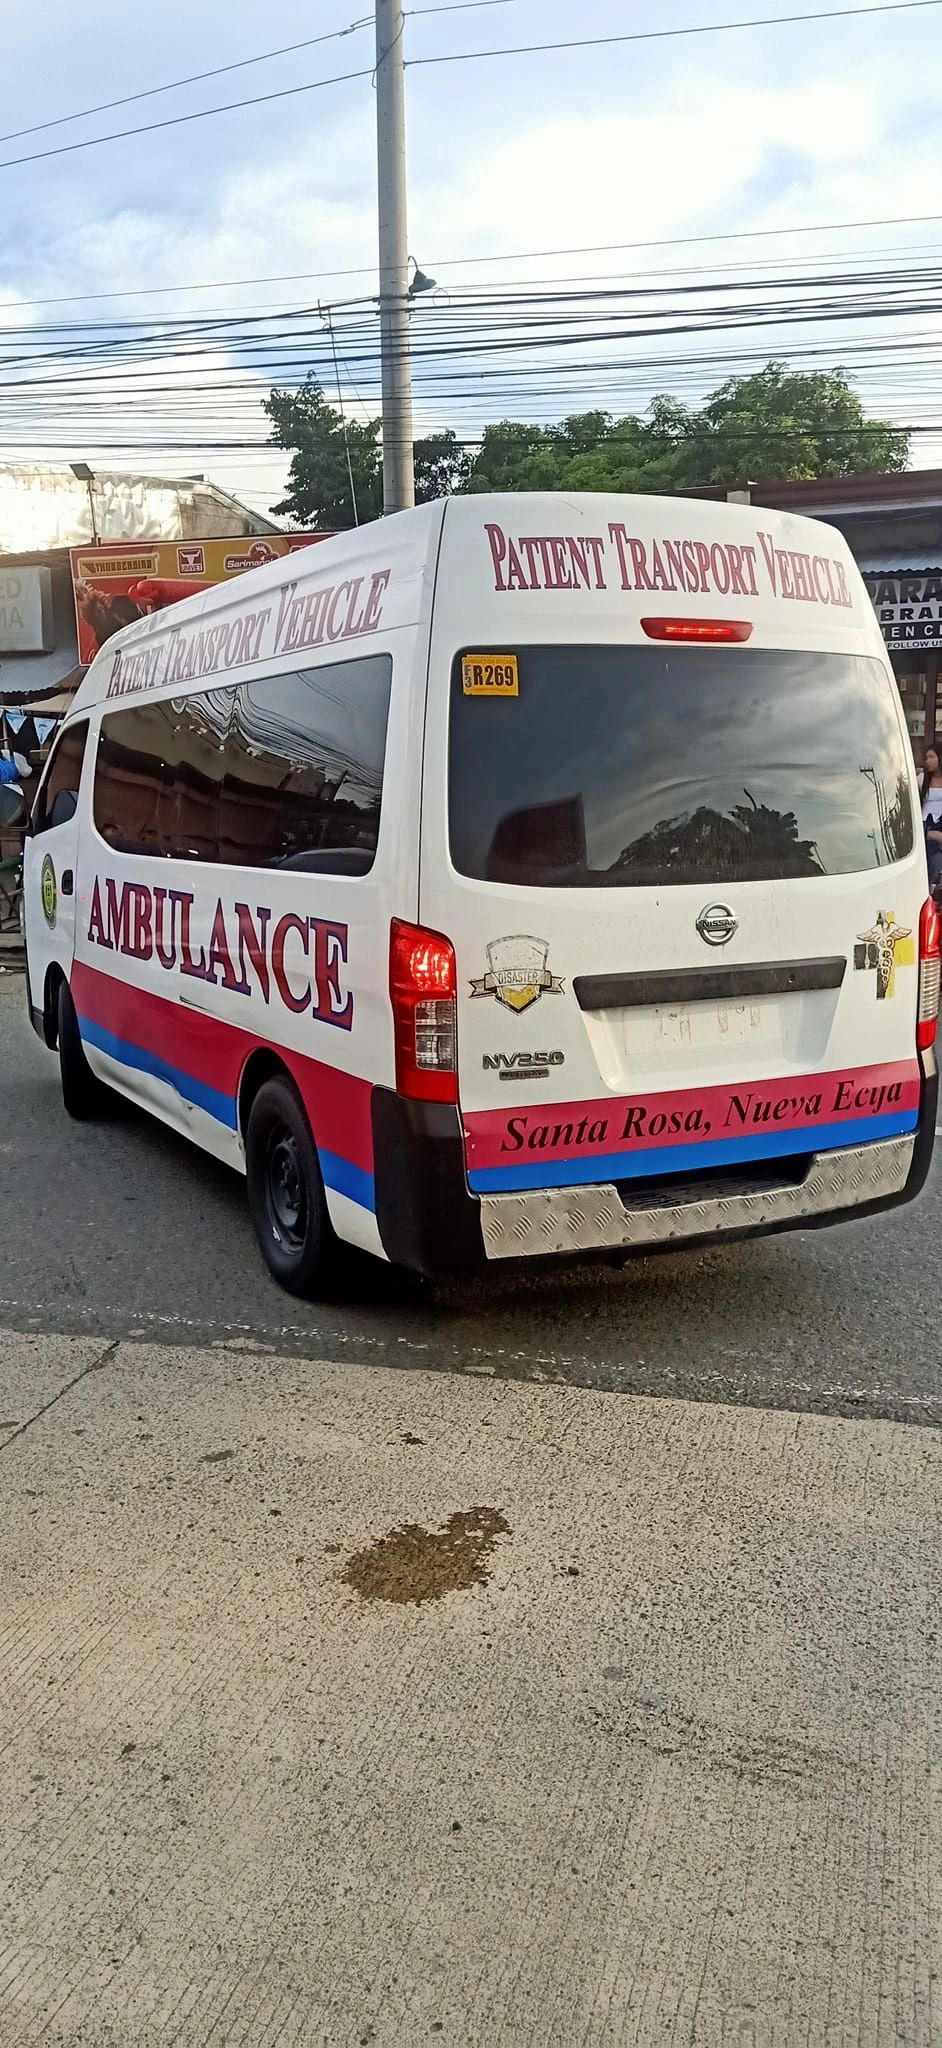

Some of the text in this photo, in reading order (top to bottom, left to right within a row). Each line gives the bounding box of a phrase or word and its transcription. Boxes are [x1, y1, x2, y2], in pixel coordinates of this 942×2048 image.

[484, 523, 853, 608] PATIENT TRANSPORT VEHICLE
[880, 606, 942, 621] BRA
[106, 568, 391, 699] PATIENT TRANSPORT VEHICLE
[888, 641, 929, 649] FOLLOW
[473, 665, 514, 687] R269
[703, 919, 736, 928] NISSAN
[87, 874, 355, 1031] AMBULANCE
[498, 971, 538, 984] DISASTER
[482, 1051, 565, 1070] NV350
[500, 1111, 609, 1152] Santa
[619, 1103, 712, 1140] Rosa,
[724, 1091, 822, 1127] Nueva
